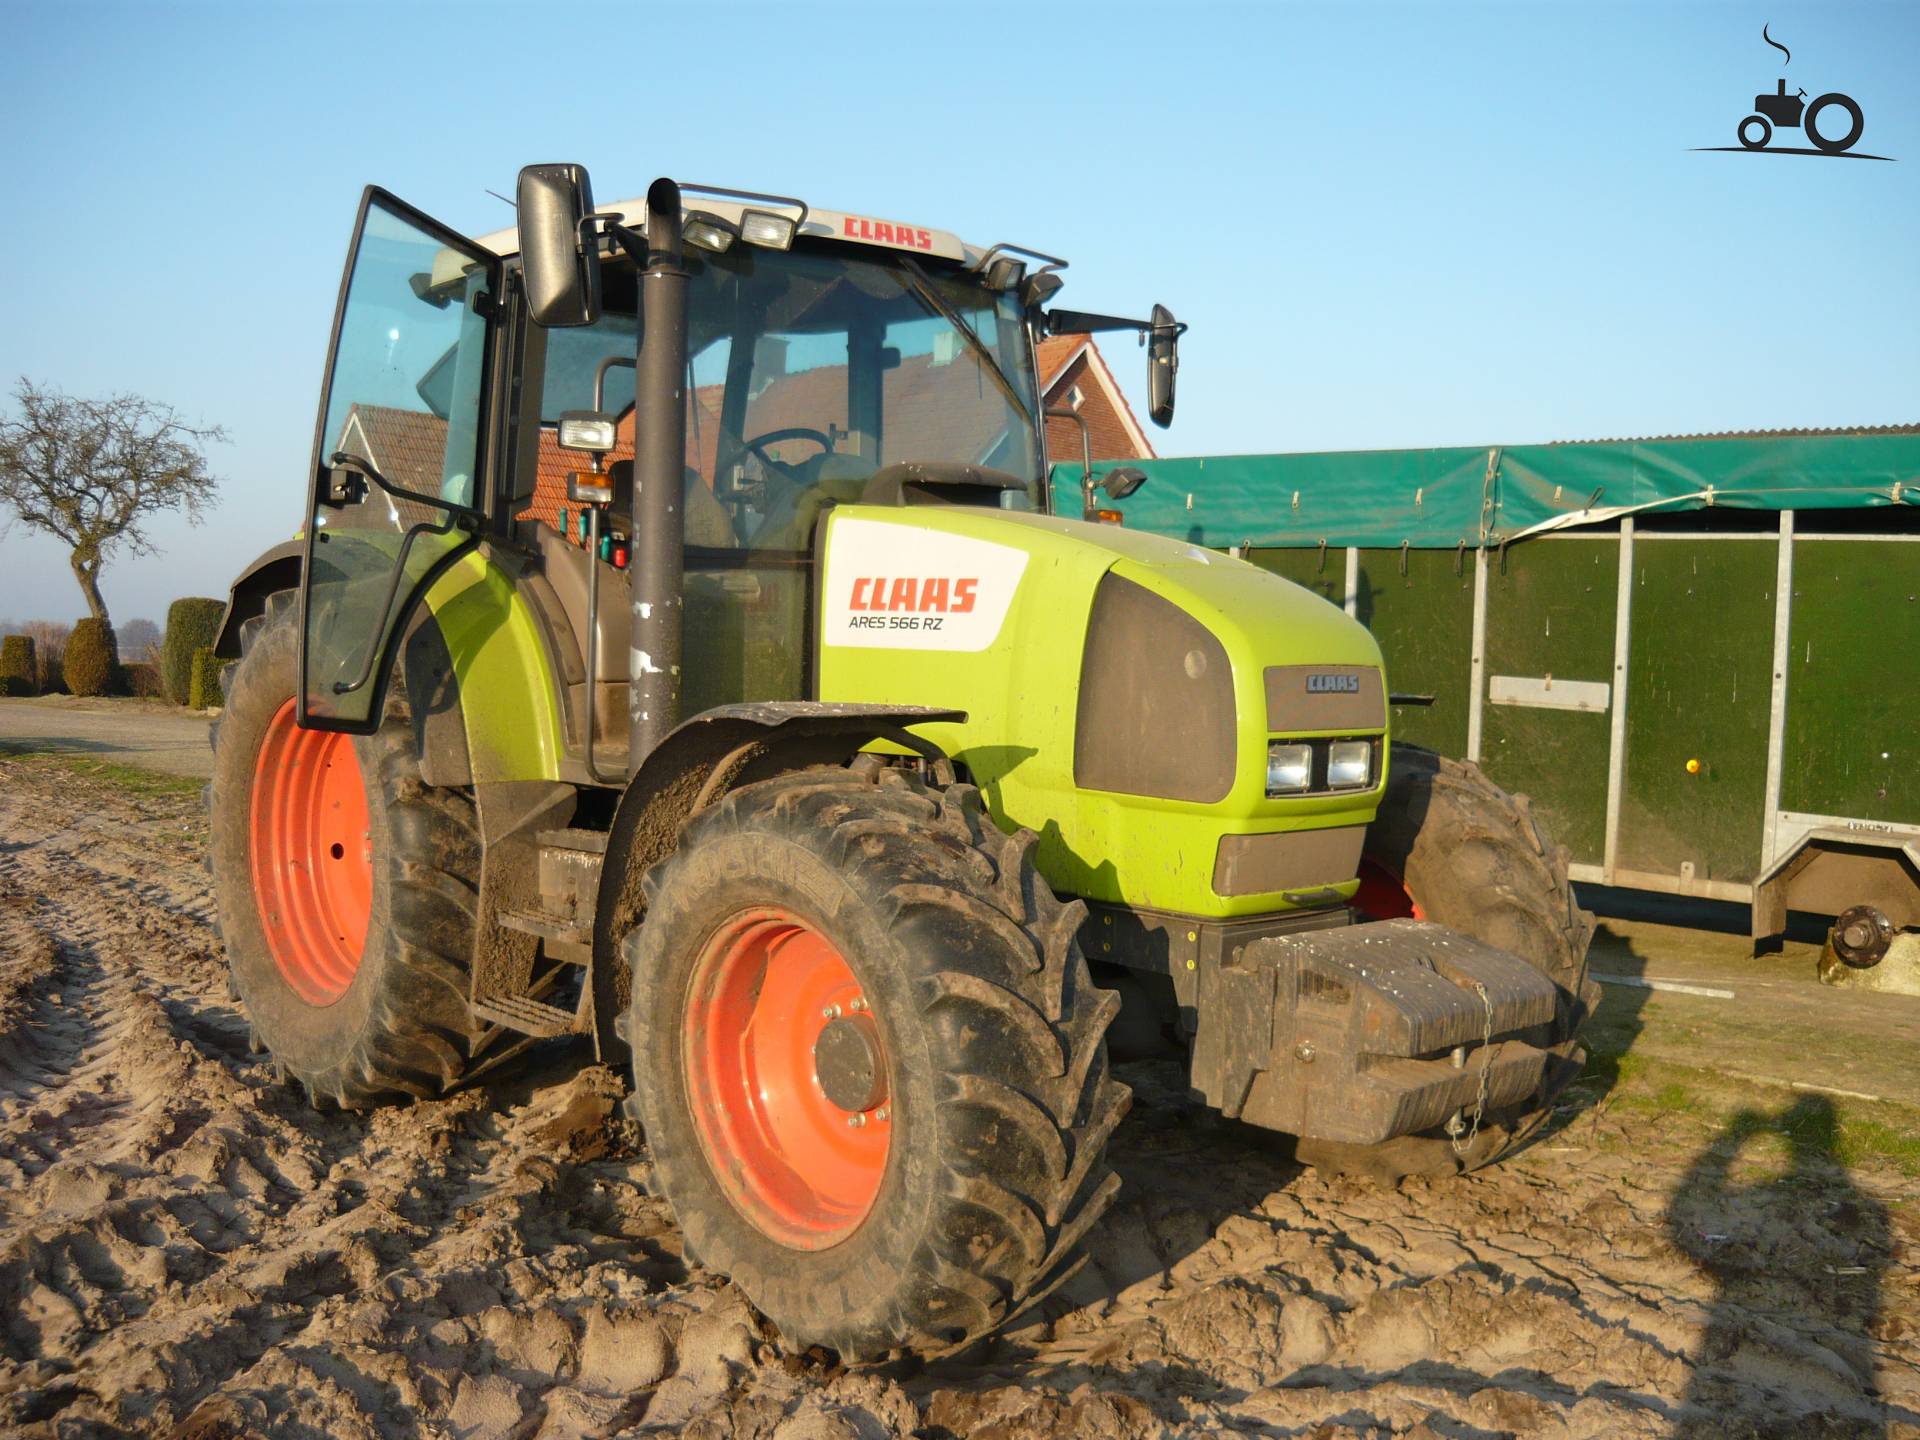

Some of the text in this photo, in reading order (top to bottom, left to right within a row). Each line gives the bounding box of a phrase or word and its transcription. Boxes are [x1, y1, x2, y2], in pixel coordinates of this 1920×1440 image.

[844, 217, 931, 249] CLAAS
[849, 578, 978, 613] CLAAS
[849, 616, 944, 631] ARES 566 RZ
[1306, 675, 1359, 692] CLAAS
